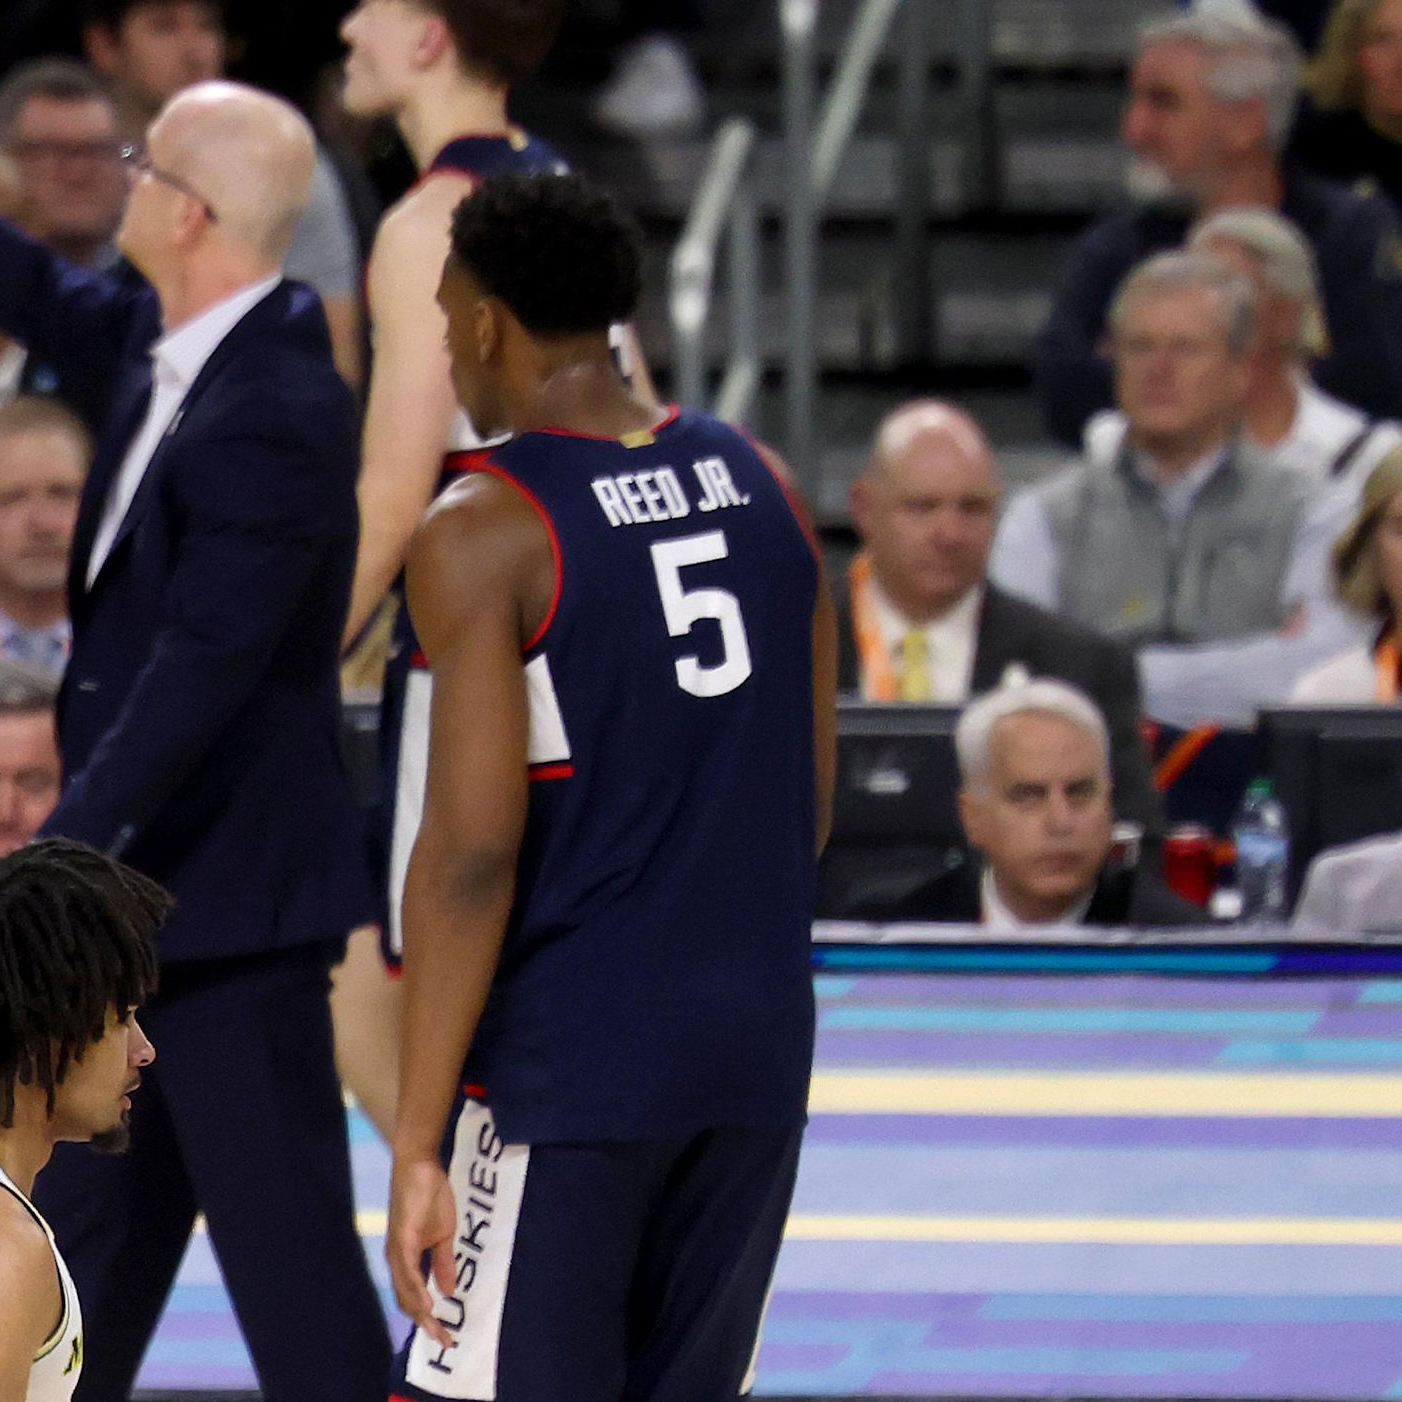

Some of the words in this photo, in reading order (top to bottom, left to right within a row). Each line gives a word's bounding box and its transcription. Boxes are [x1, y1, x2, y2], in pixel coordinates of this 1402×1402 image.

[590, 466, 691, 527] REED
[692, 455, 752, 512] JR.
[649, 529, 753, 698] 5
